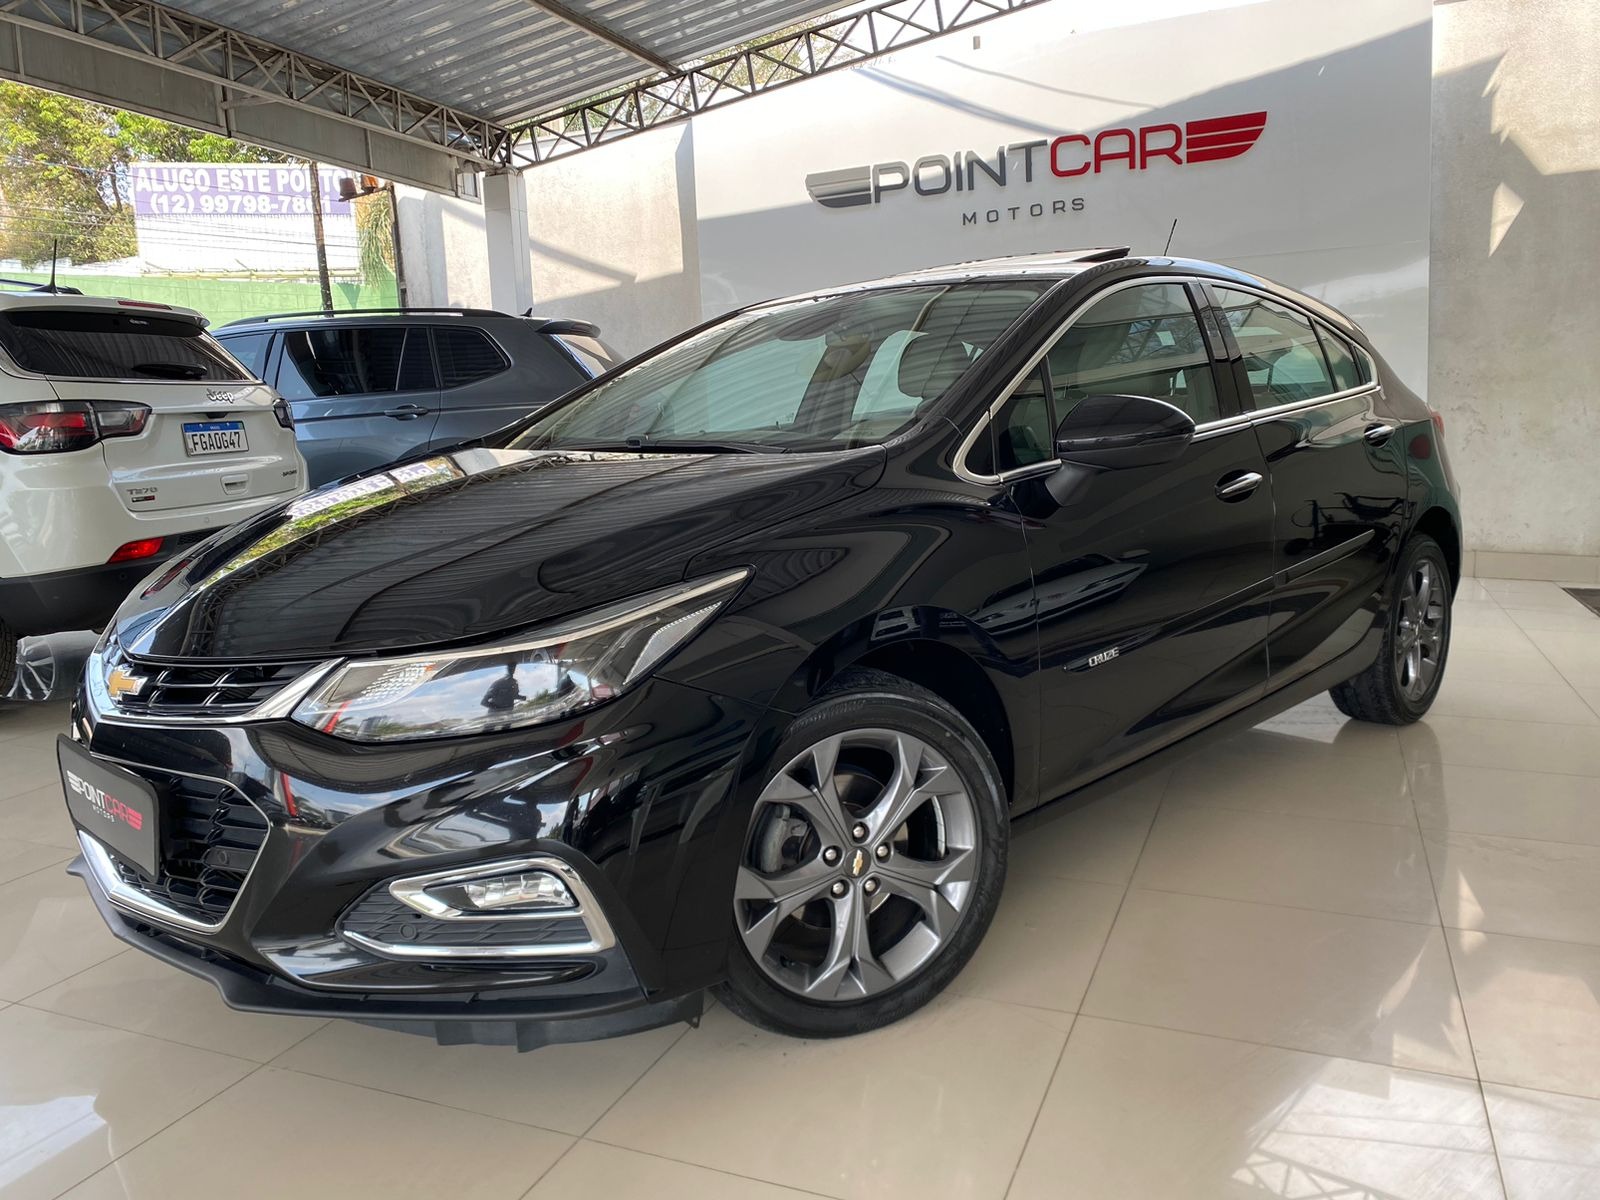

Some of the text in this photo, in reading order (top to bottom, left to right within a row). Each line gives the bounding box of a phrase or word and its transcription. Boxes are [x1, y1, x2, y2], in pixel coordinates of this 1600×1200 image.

[874, 122, 1183, 204] POINTCAR
[136, 168, 211, 193] ALUGO
[216, 168, 272, 193] ESTE
[150, 192, 195, 214] (12)
[962, 197, 1086, 226] MOTORS
[206, 388, 234, 404] Jeep
[1088, 646, 1120, 667] CRUZE
